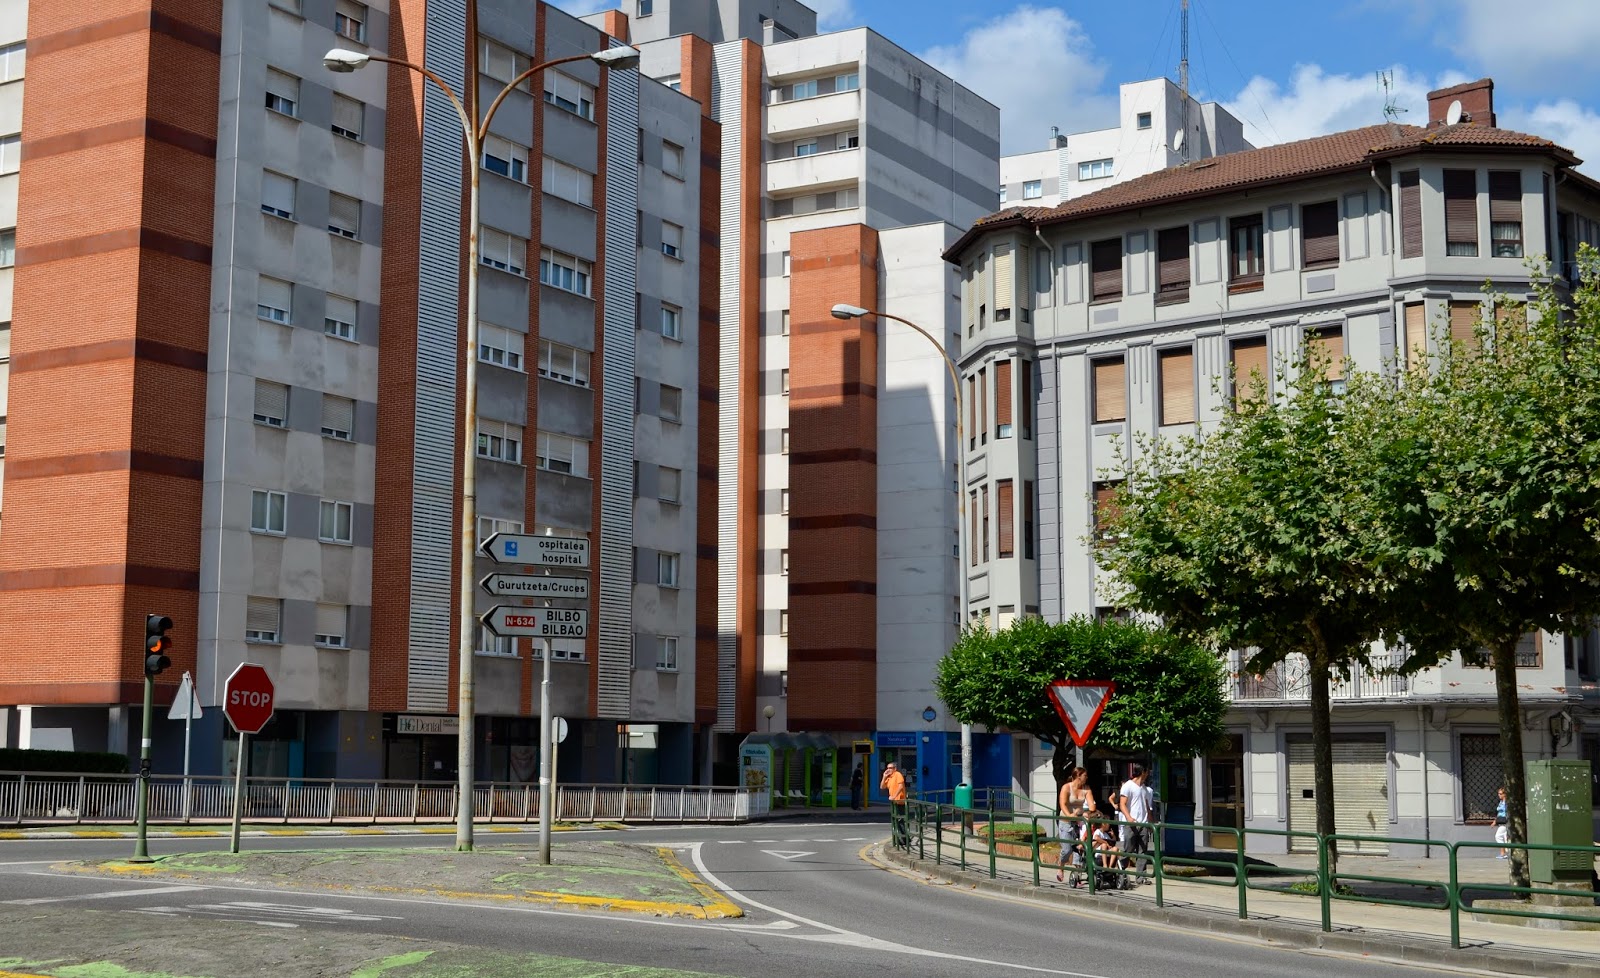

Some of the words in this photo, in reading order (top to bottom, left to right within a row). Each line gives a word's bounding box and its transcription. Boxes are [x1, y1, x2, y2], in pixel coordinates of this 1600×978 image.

[538, 540, 585, 551] ospitalea
[542, 554, 582, 564] hospital
[498, 580, 586, 593] Gurutzeta/Cruces
[546, 610, 580, 622] BILBO
[542, 625, 584, 636] BILBAO
[230, 690, 270, 708] STOP
[416, 718, 442, 732] Dental
